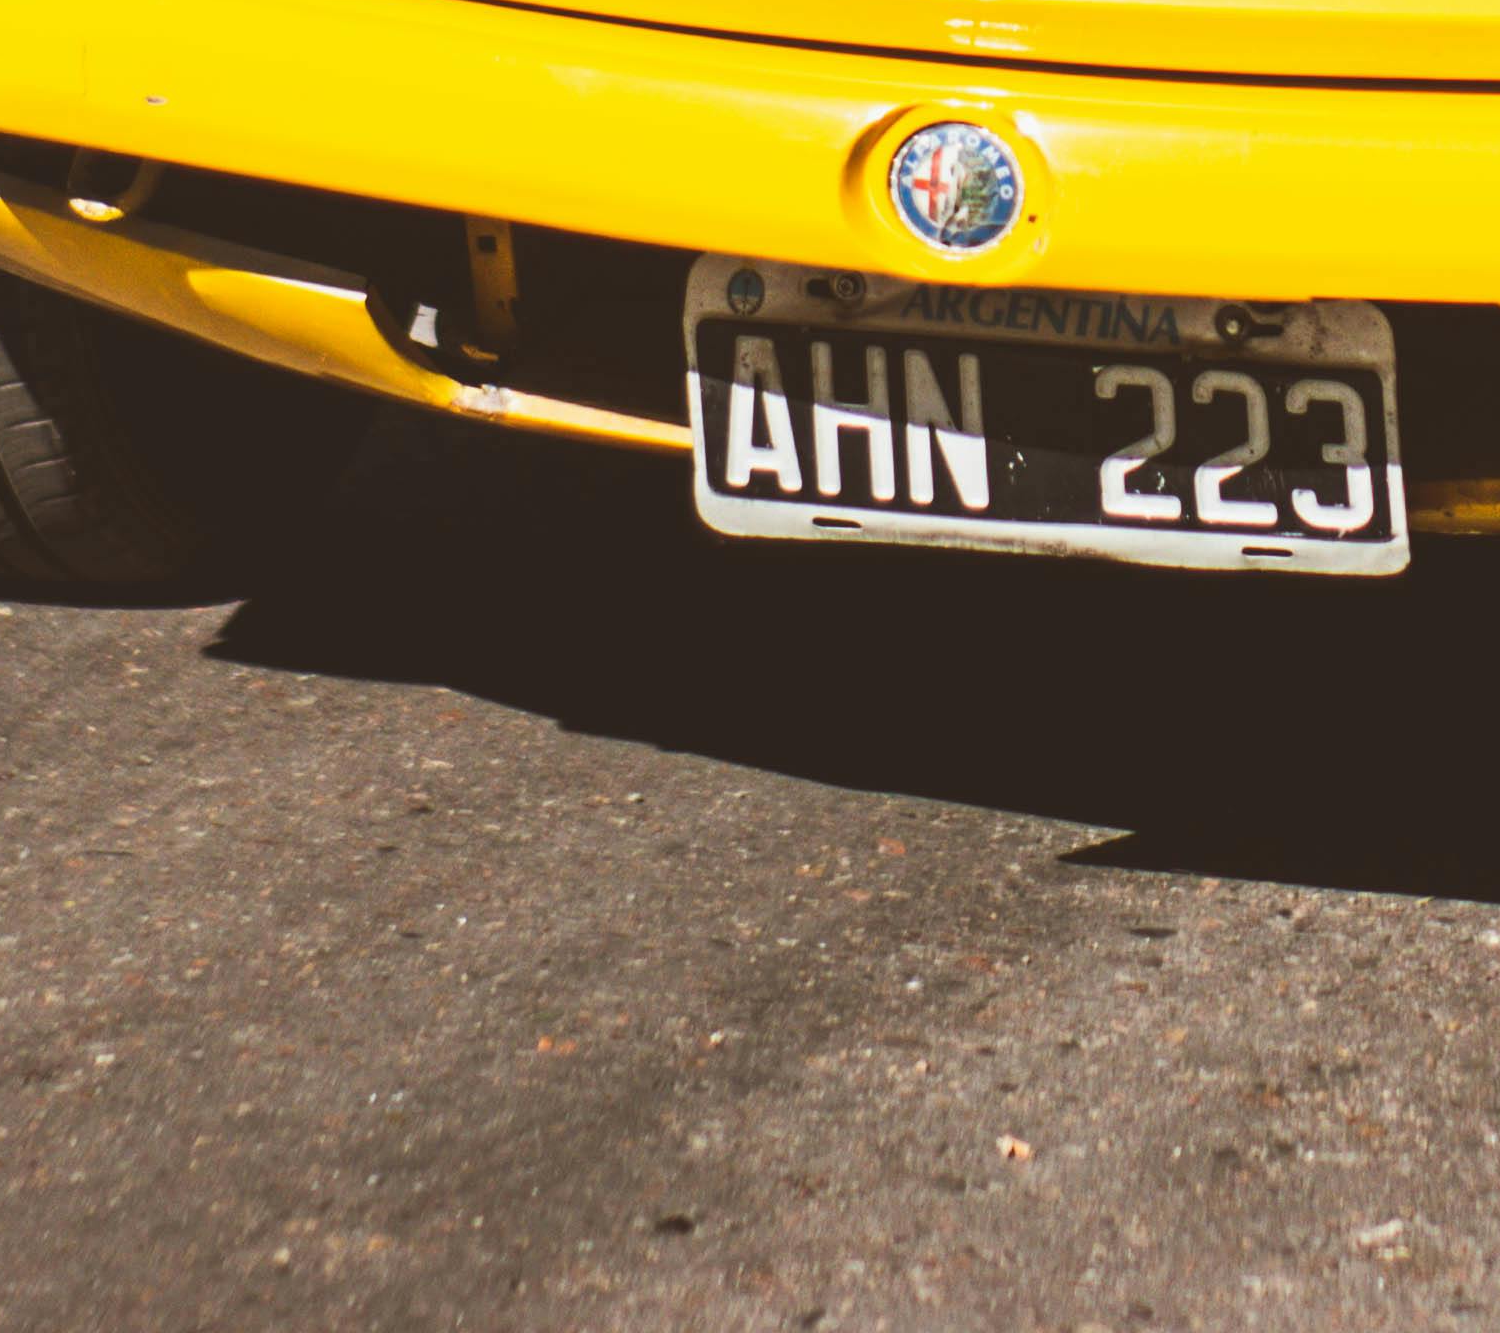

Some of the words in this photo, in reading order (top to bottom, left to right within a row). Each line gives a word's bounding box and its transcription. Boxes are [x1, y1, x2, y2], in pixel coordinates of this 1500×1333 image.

[901, 282, 1181, 346] ARGENTINA
[726, 334, 990, 511] AHN
[1093, 365, 1376, 531] 223
